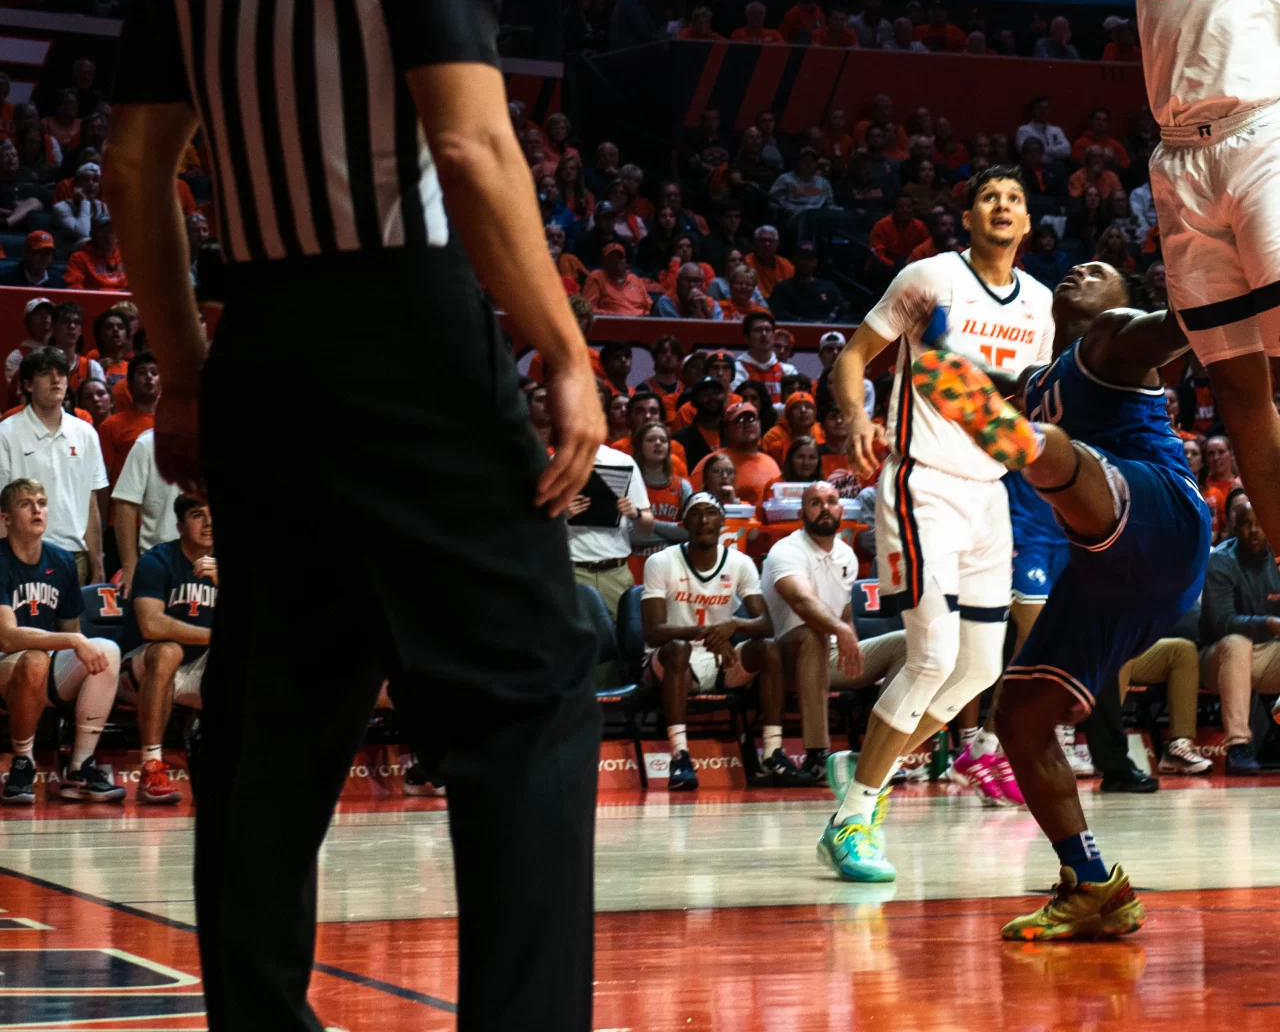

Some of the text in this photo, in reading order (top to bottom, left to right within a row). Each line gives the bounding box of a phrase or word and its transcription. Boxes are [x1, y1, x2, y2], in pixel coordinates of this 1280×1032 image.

[962, 319, 1036, 344] ILLINOIS
[13, 581, 60, 611] ILLINOIS
[674, 591, 731, 606] ILLINOIS
[695, 608, 706, 628] 1
